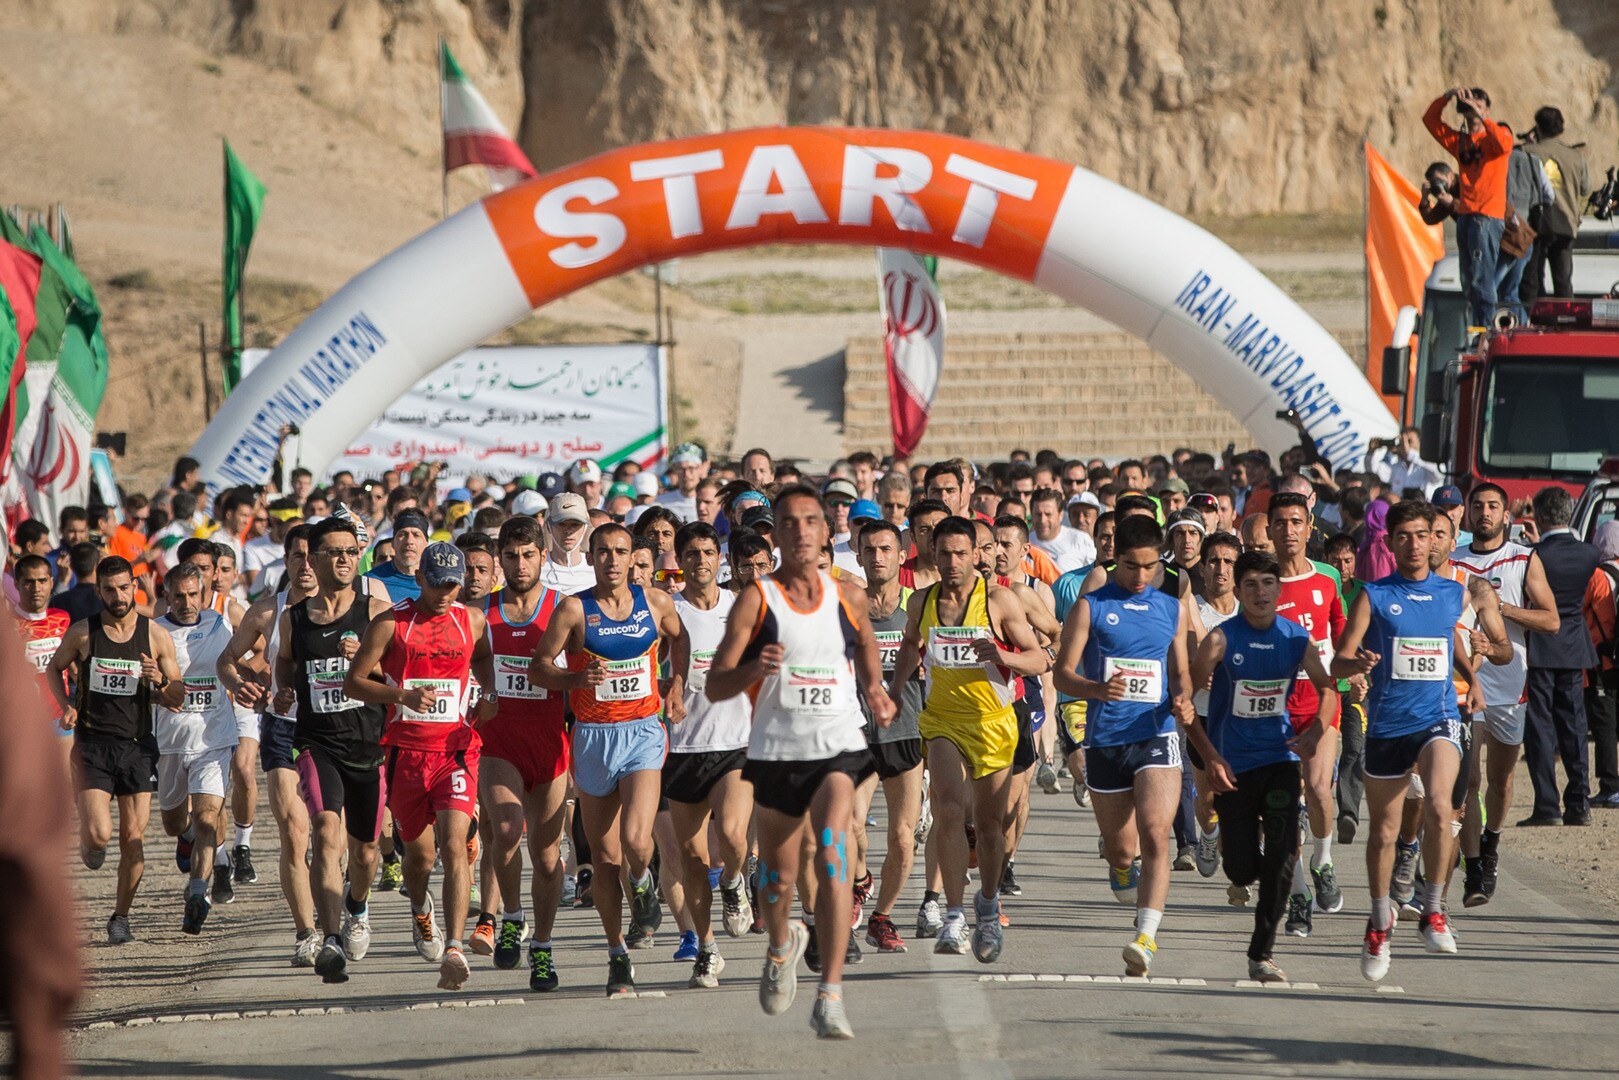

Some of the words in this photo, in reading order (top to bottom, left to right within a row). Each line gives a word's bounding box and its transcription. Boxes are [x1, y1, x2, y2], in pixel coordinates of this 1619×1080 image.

[533, 144, 1038, 269] START
[299, 309, 388, 402] MARATHON
[544, 441, 557, 461] و
[559, 436, 604, 461] صلح
[598, 623, 640, 636] saucony
[1298, 612, 1315, 632] 15
[942, 645, 971, 661] 112
[1408, 657, 1436, 673] 193
[102, 674, 127, 690] 134
[610, 677, 641, 694] 132
[188, 691, 212, 706] 168
[799, 687, 832, 706] 128
[1249, 697, 1277, 712] 198
[451, 768, 467, 793] 5
